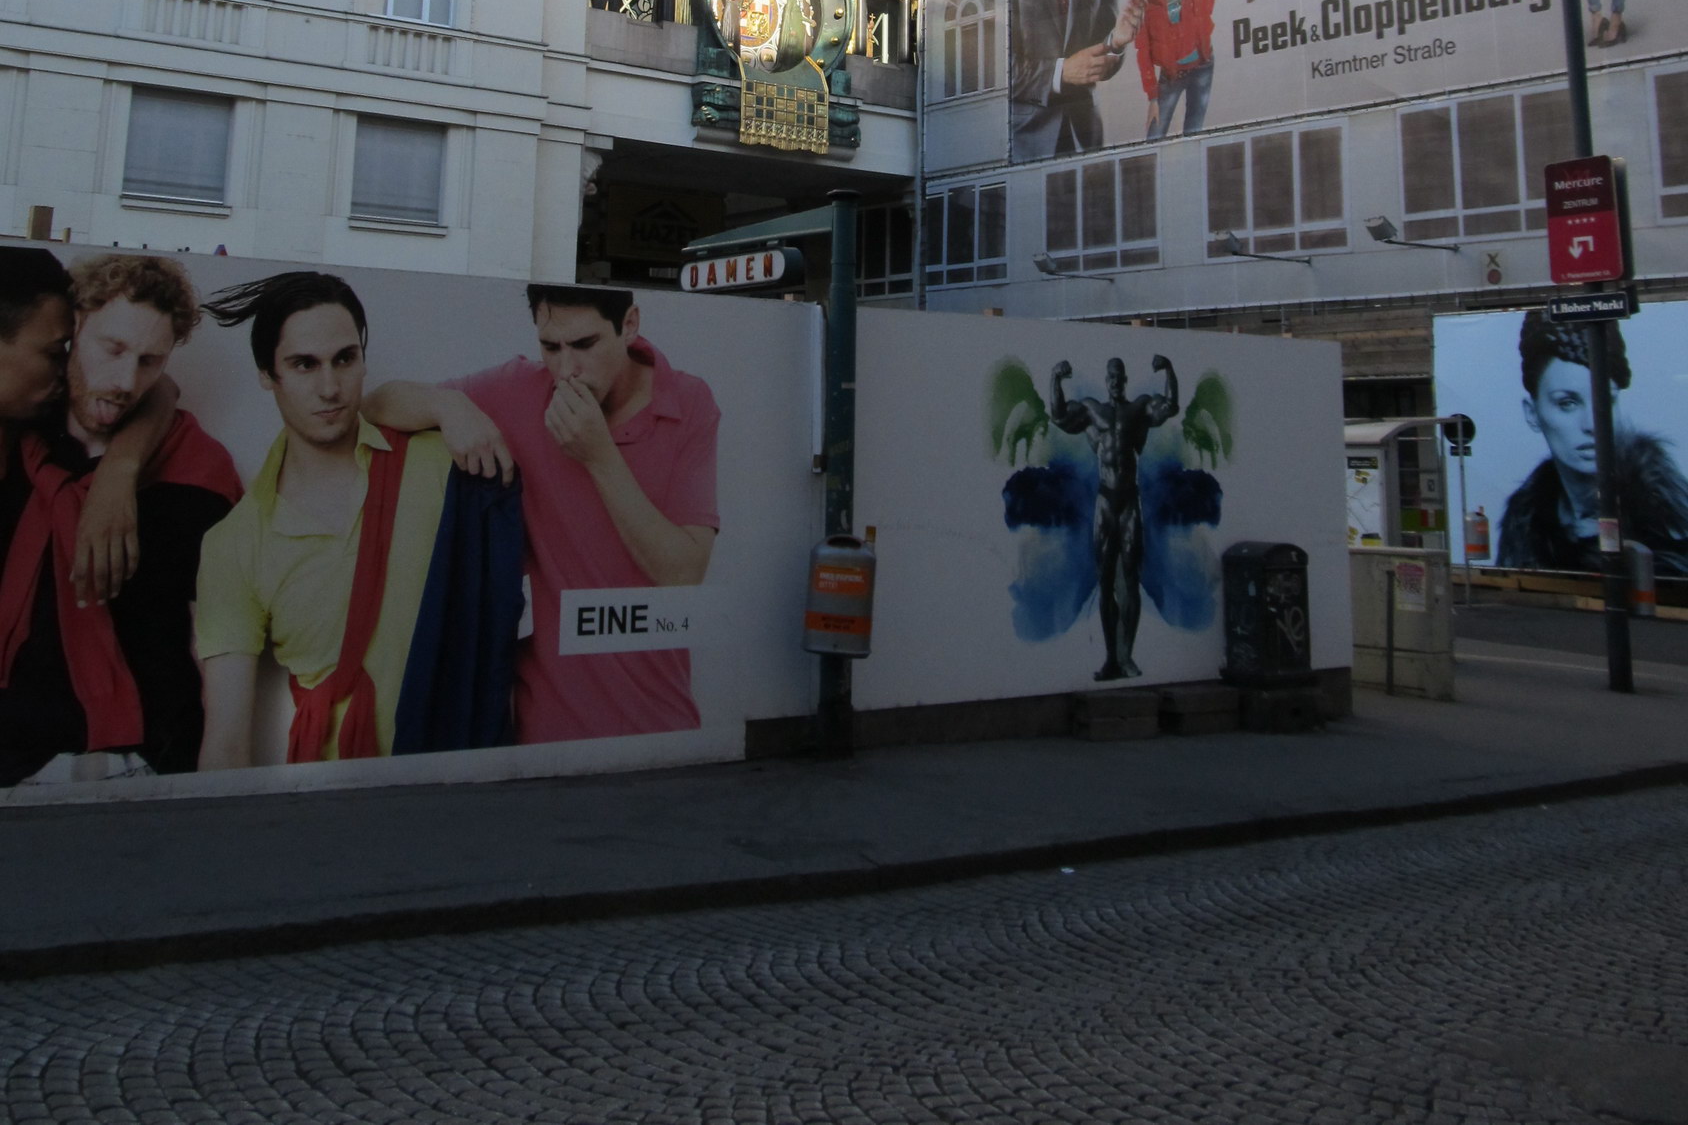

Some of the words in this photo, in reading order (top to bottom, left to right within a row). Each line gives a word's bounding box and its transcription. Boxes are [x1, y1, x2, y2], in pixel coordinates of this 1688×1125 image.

[1310, 50, 1388, 79] Kärntner
[1393, 37, 1457, 65] Straße
[1554, 176, 1604, 191] Mercure
[1562, 197, 1599, 210] ZENTRUM
[689, 252, 774, 289] DAMEN
[1593, 299, 1624, 312] Markt
[576, 604, 649, 636] EINE
[655, 618, 678, 633] No.
[681, 617, 690, 631] 4
